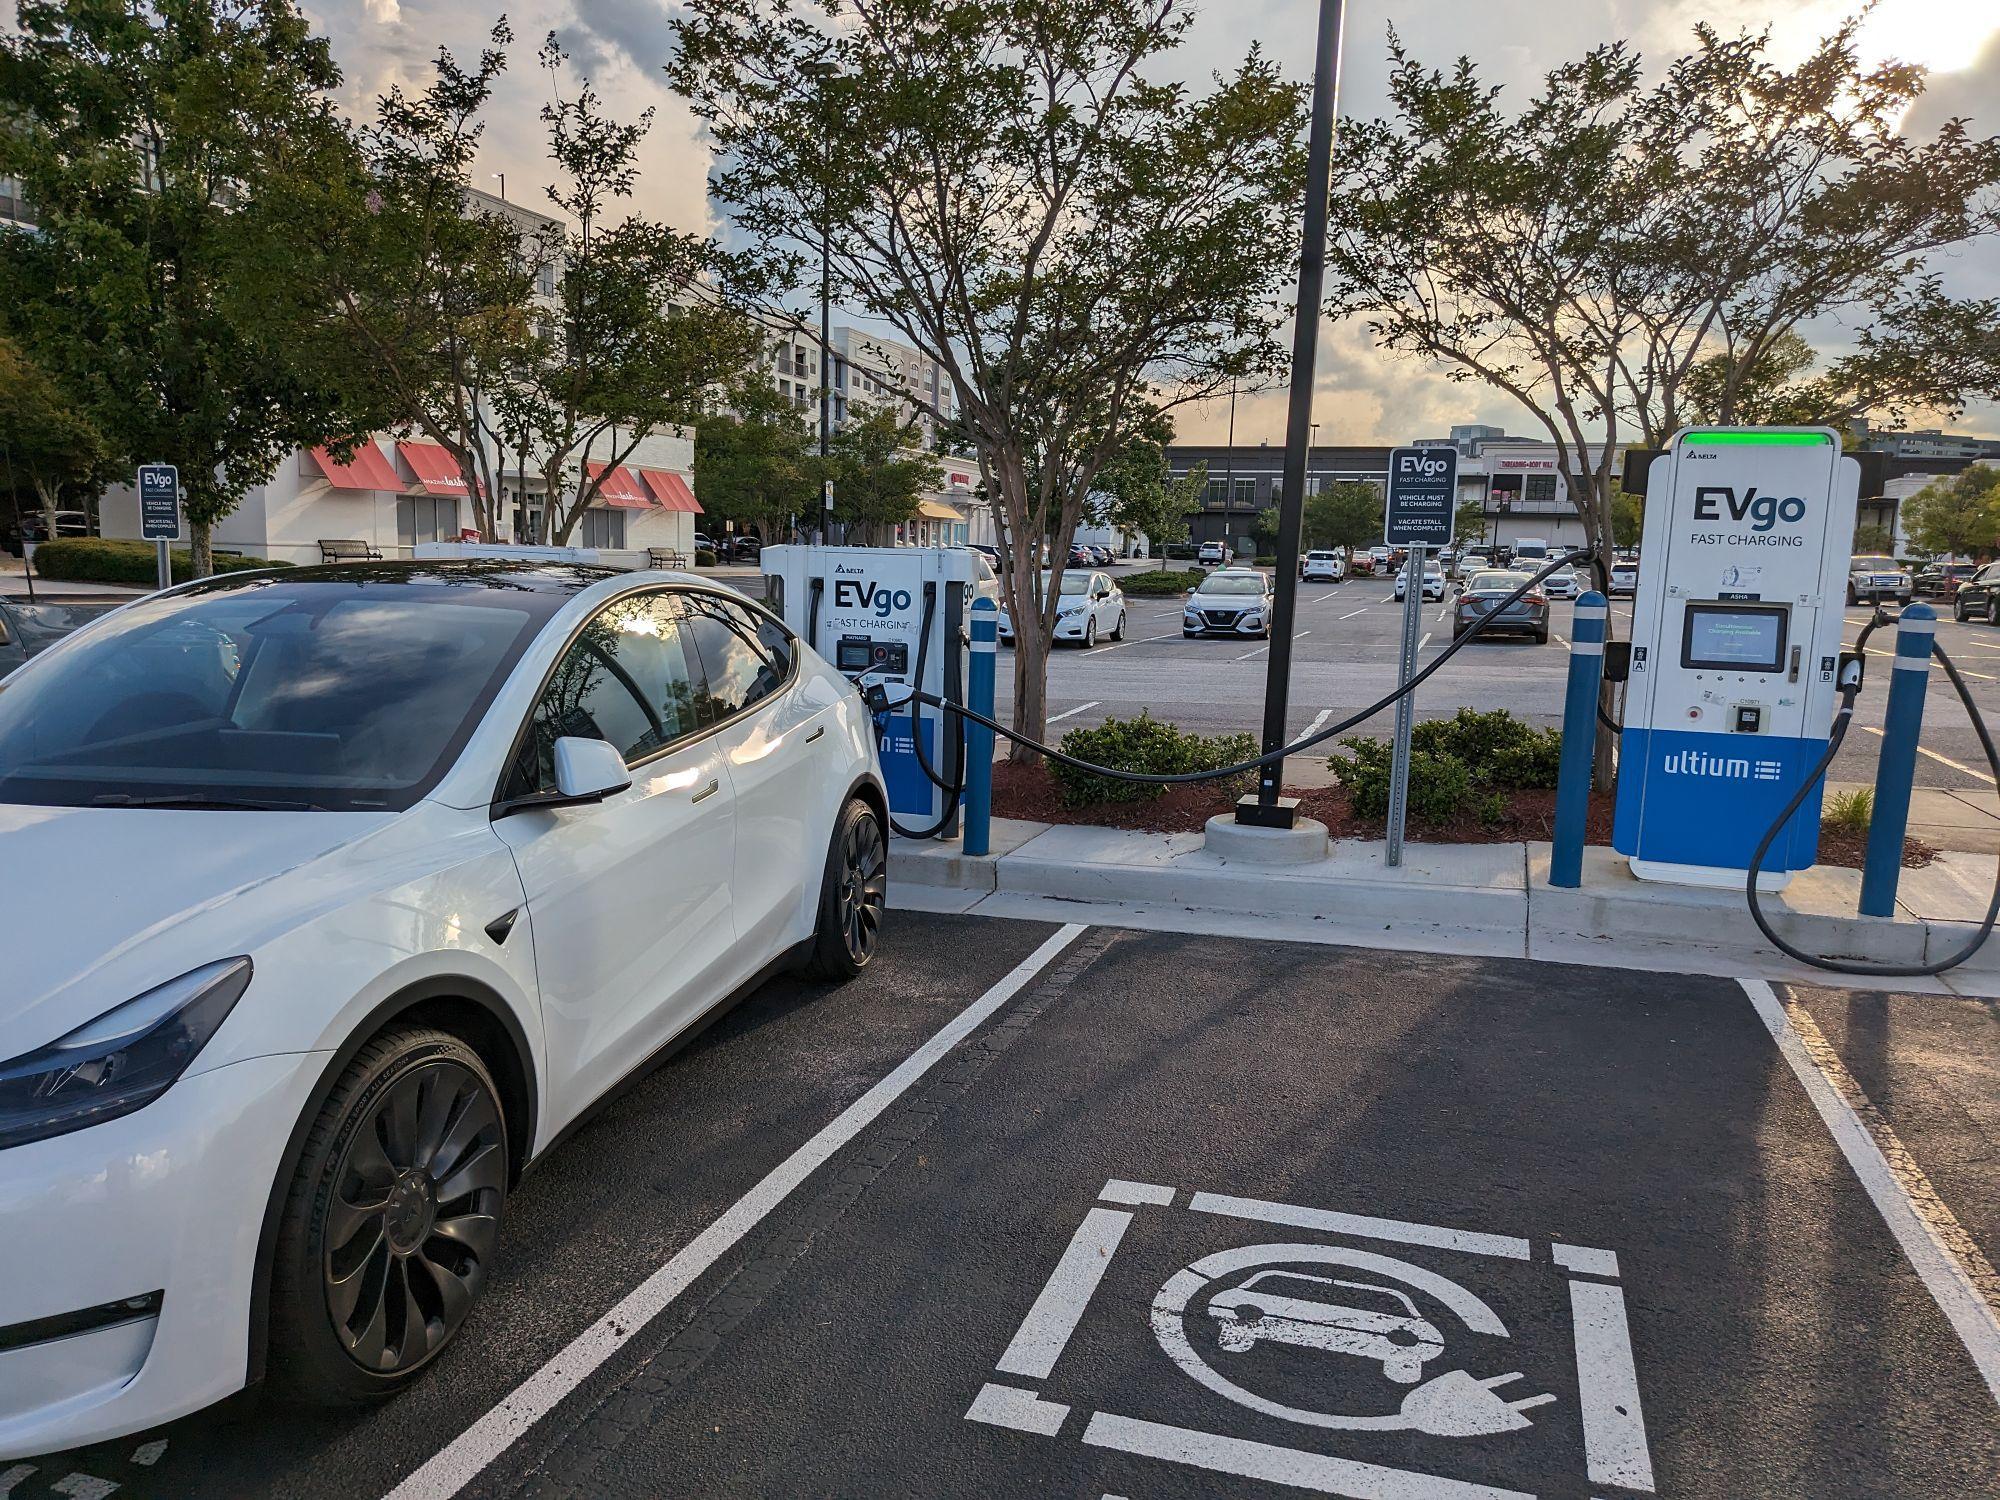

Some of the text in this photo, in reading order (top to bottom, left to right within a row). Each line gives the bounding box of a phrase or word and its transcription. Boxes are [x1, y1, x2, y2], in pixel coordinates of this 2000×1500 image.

[1401, 456, 1448, 476] EVgo
[145, 473, 171, 487] EVgo
[1694, 487, 1806, 531] EVgo
[1690, 533, 1803, 547] FAST CHARGING
[835, 580, 912, 617] EVgo
[1635, 662, 1643, 670] A
[1823, 672, 1830, 680] B
[1664, 750, 1749, 778] ultium
